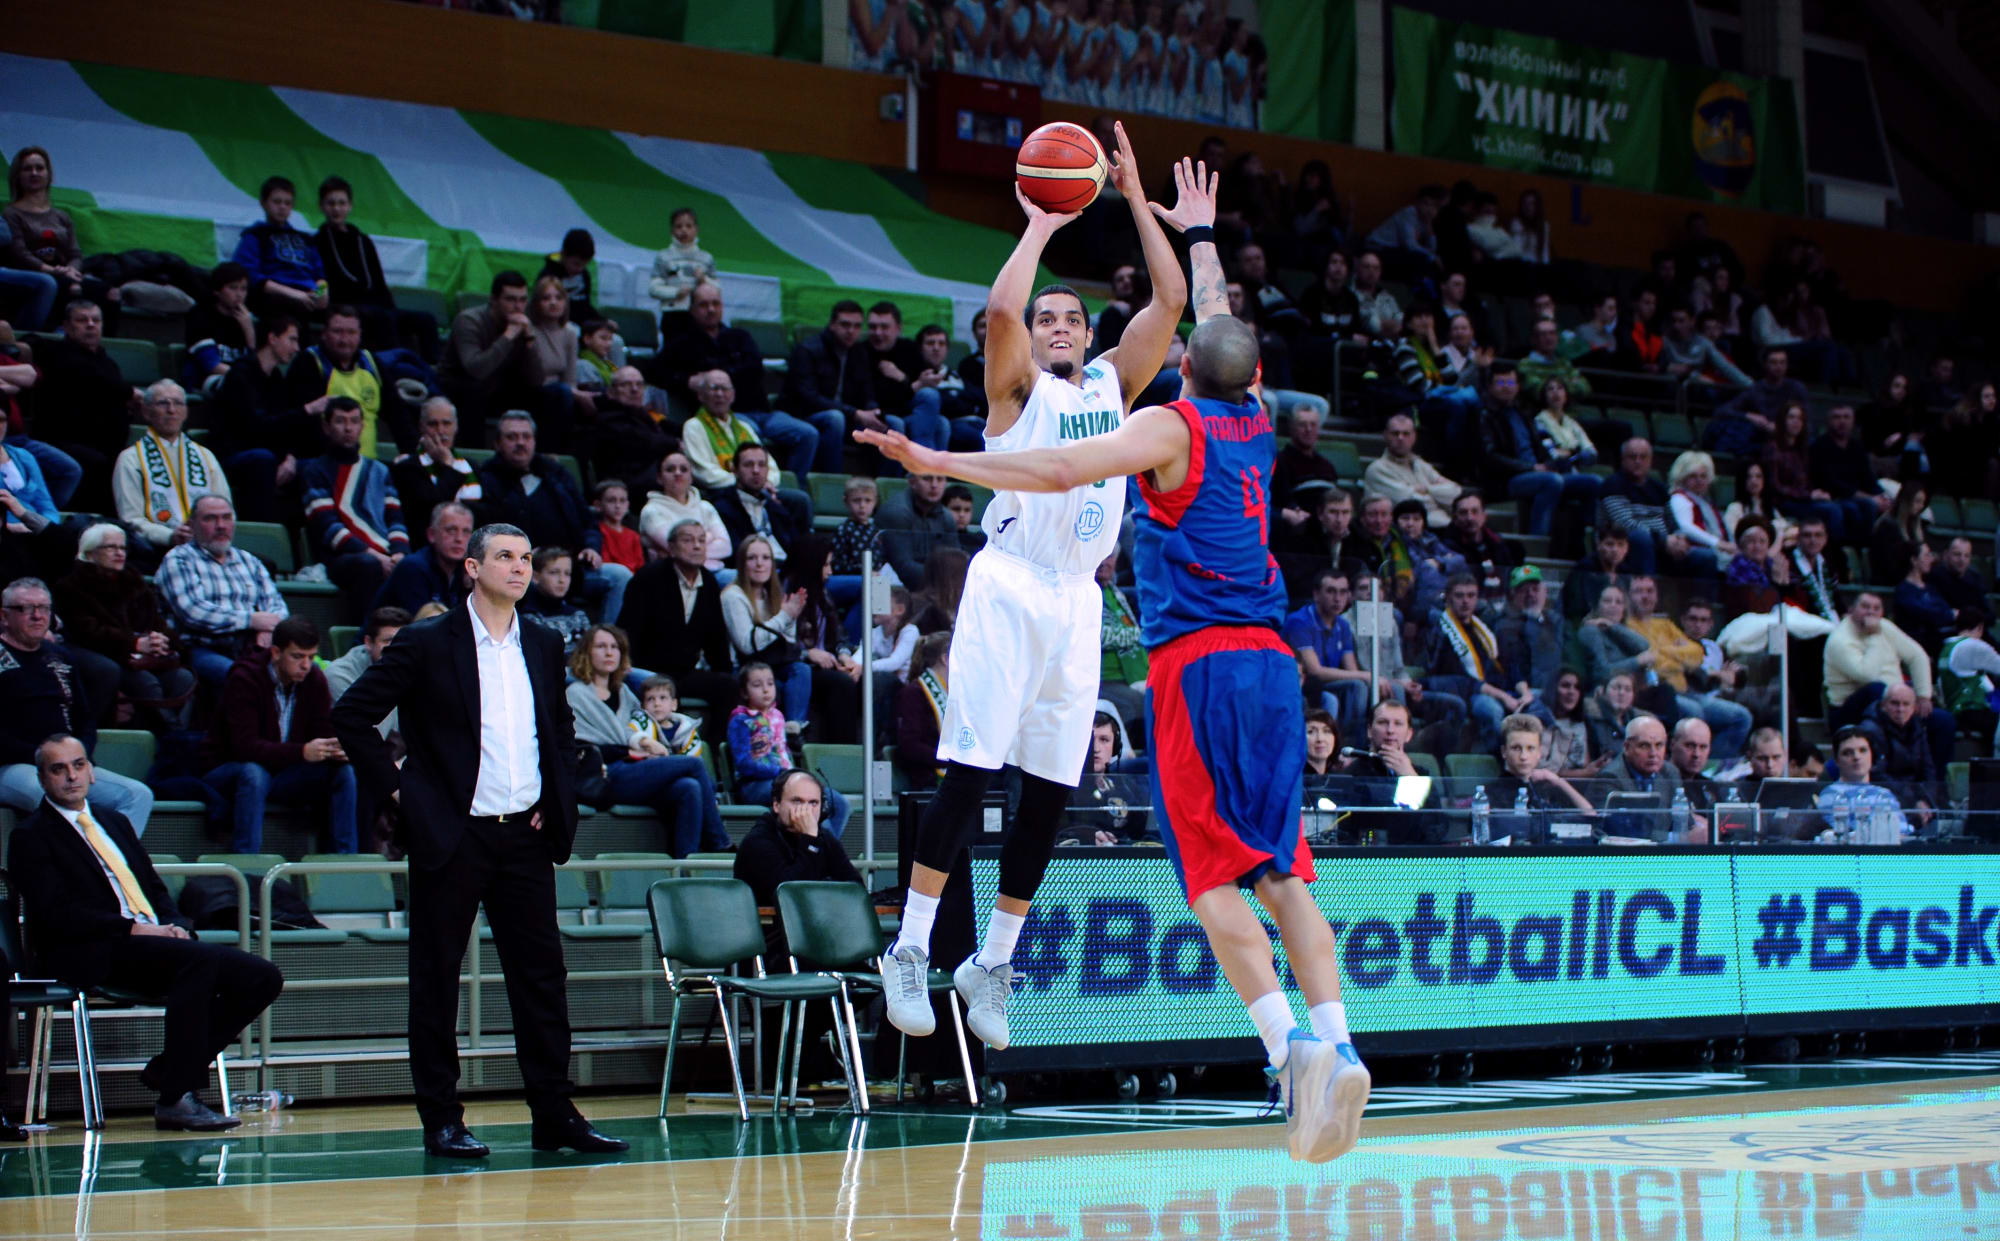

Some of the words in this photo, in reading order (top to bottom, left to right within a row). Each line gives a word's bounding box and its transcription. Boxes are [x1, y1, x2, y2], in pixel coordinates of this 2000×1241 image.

[1240, 465, 1268, 546] 4
[1012, 889, 1726, 996] #BaetballCL
[1753, 885, 2000, 972] #Bask
